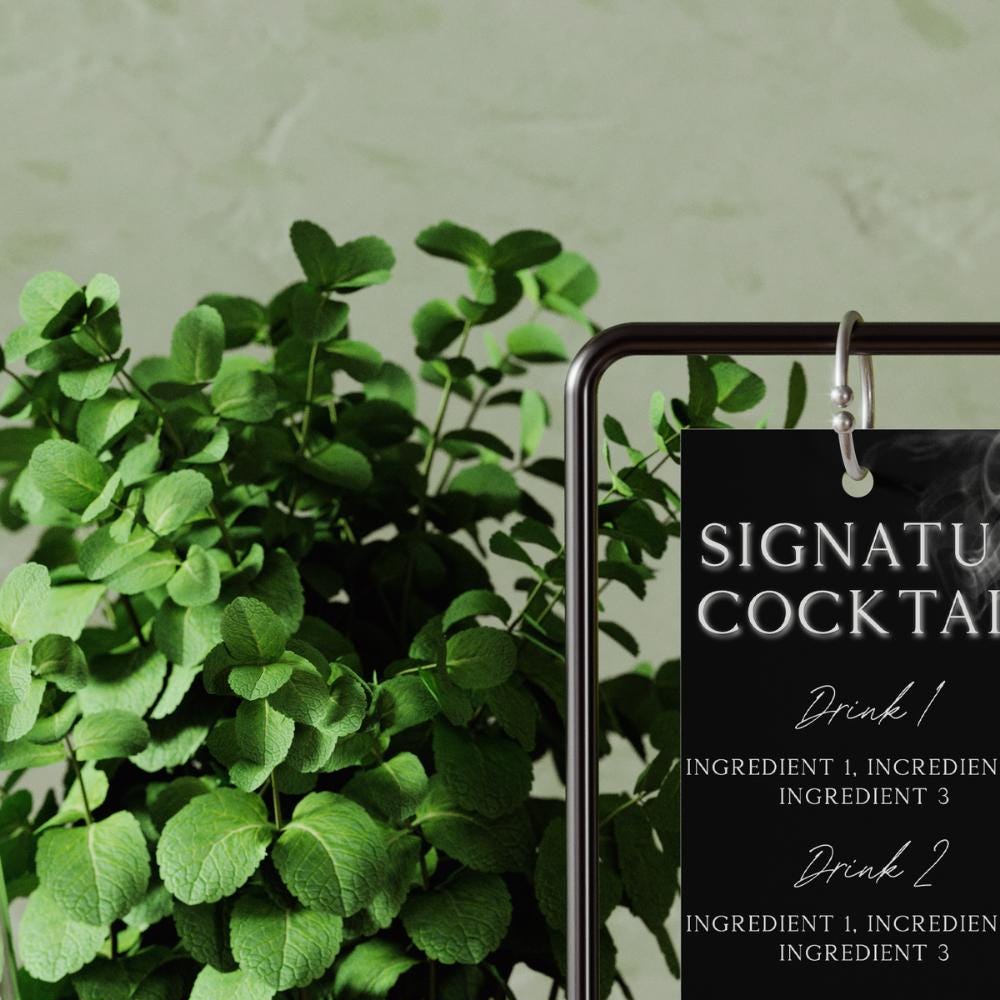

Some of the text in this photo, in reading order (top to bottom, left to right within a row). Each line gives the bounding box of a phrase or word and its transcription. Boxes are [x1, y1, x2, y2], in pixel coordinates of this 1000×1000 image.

[795, 681, 945, 729] Drink 1
[686, 757, 835, 776] INGREDIENT
[844, 758, 857, 777] 1,
[779, 786, 950, 805] INGREDIENT 3
[794, 839, 949, 888] Drink 2
[686, 914, 835, 933] INGREDIENT
[845, 915, 857, 934] 1,
[779, 943, 950, 962] INGREDIENT 3
